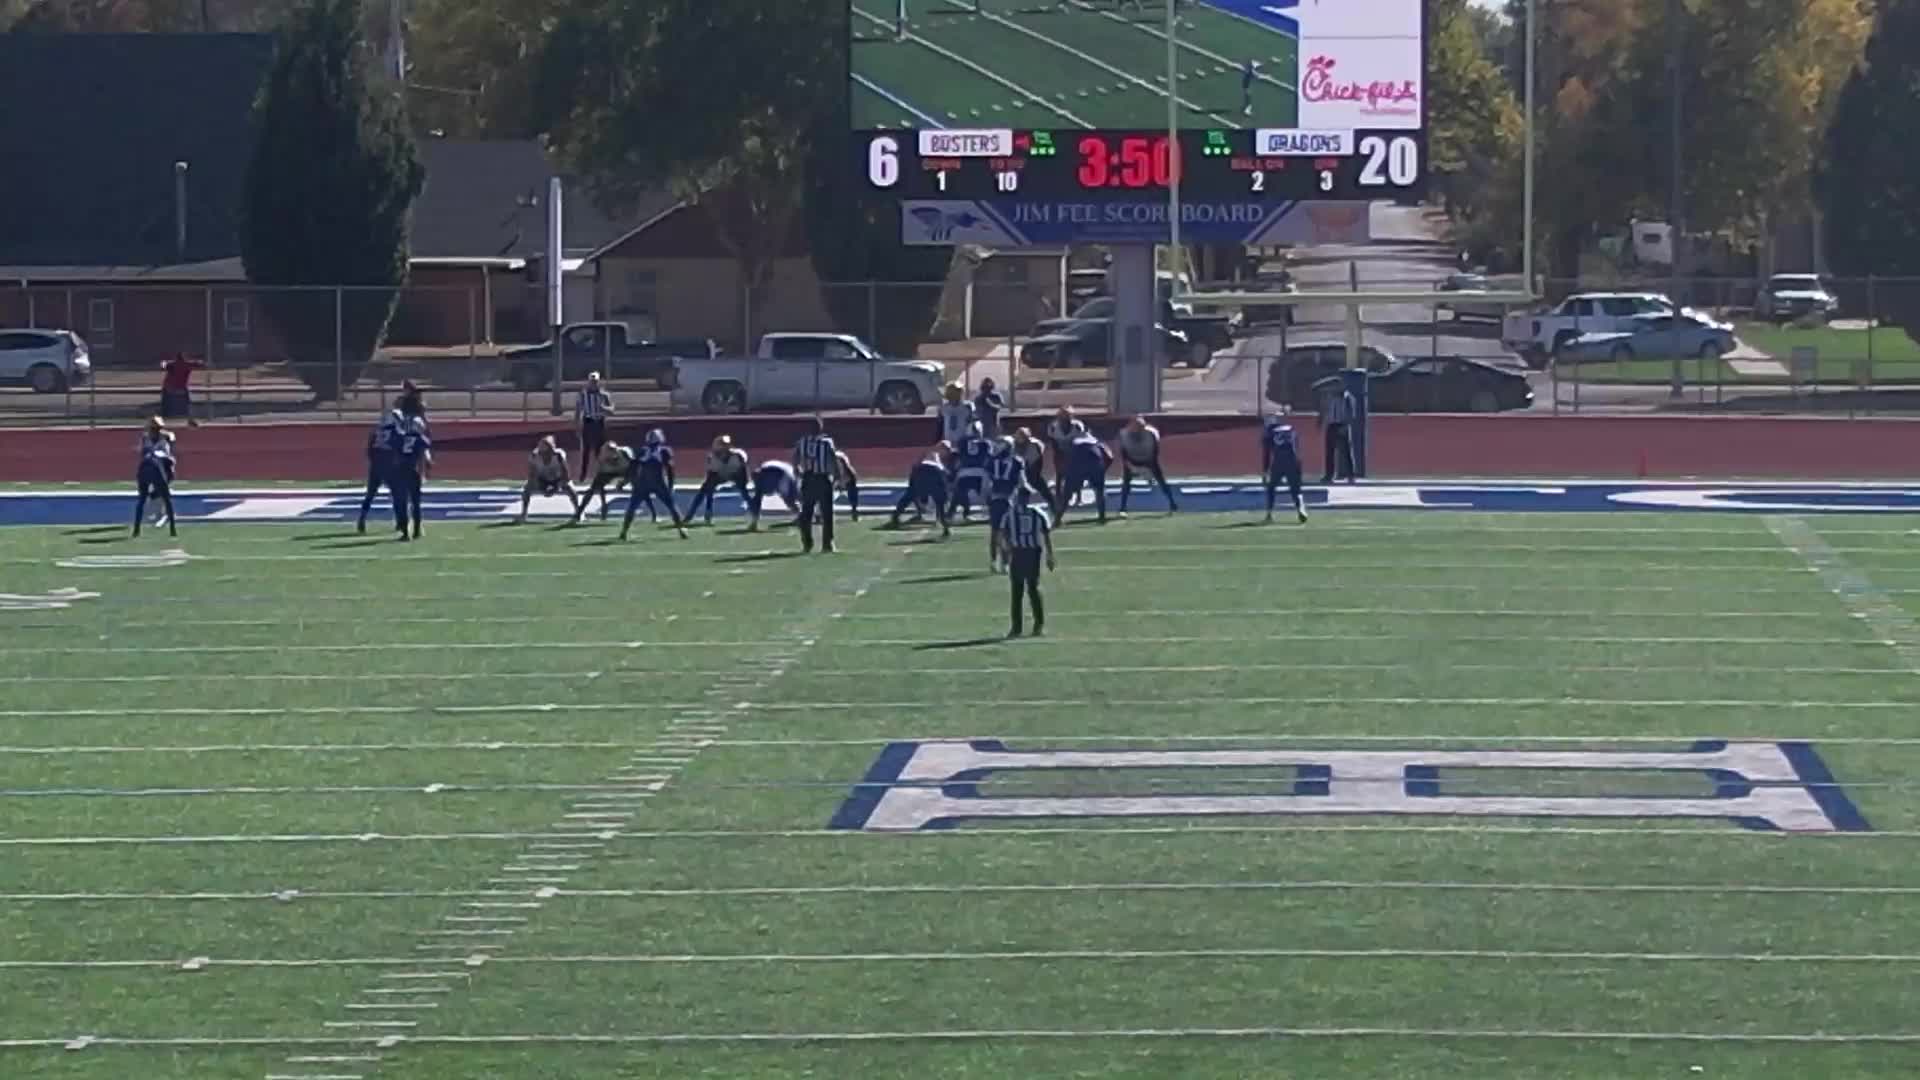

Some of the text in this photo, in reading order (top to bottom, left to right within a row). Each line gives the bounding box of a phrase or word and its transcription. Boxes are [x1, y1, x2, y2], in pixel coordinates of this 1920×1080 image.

[930, 134, 1000, 152] BUSTERS
[1268, 134, 1342, 152] DRAGONS
[869, 136, 899, 186] 6
[1078, 137, 1182, 187] 3:50
[1359, 136, 1418, 186] 20
[936, 171, 946, 191] 1
[997, 171, 1018, 191] 10
[1251, 171, 1264, 191] 2
[1320, 171, 1333, 191] 3
[1013, 203, 1050, 223] JIM
[1104, 203, 1264, 223] SCORBOARD
[992, 459, 1013, 480] 17
